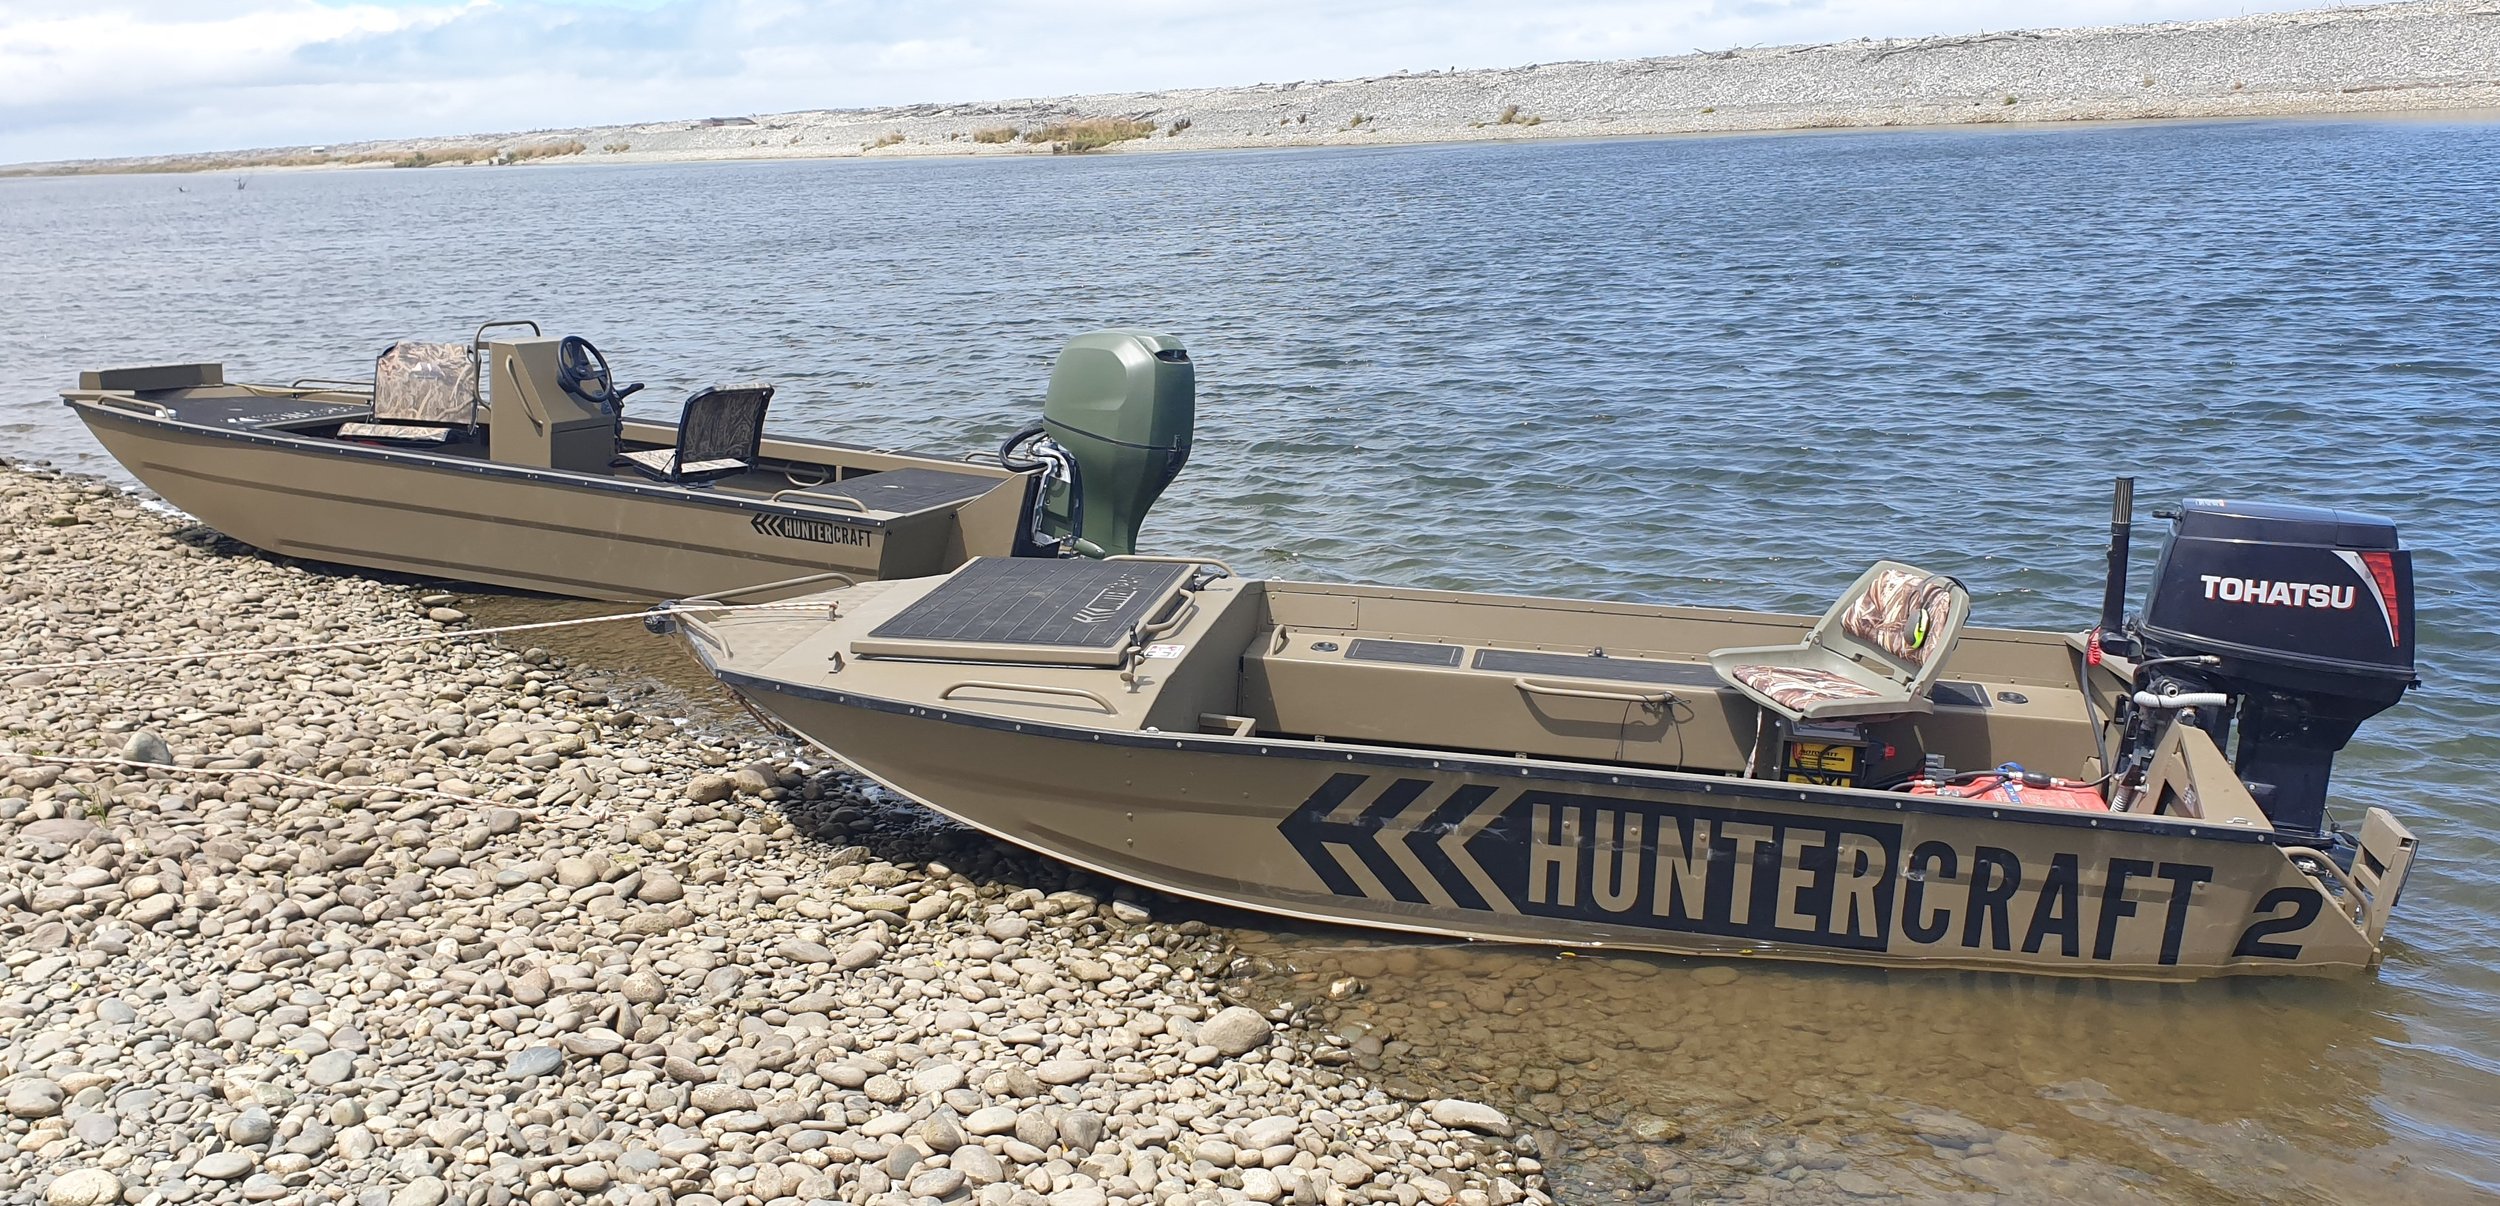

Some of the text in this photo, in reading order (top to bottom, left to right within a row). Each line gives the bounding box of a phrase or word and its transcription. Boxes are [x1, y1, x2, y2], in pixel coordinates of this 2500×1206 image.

[784, 518, 872, 548] HUNTERCRAFT
[2200, 574, 2356, 610] TOHATSU
[1528, 803, 2324, 966] HUNTERCRAFT 2
